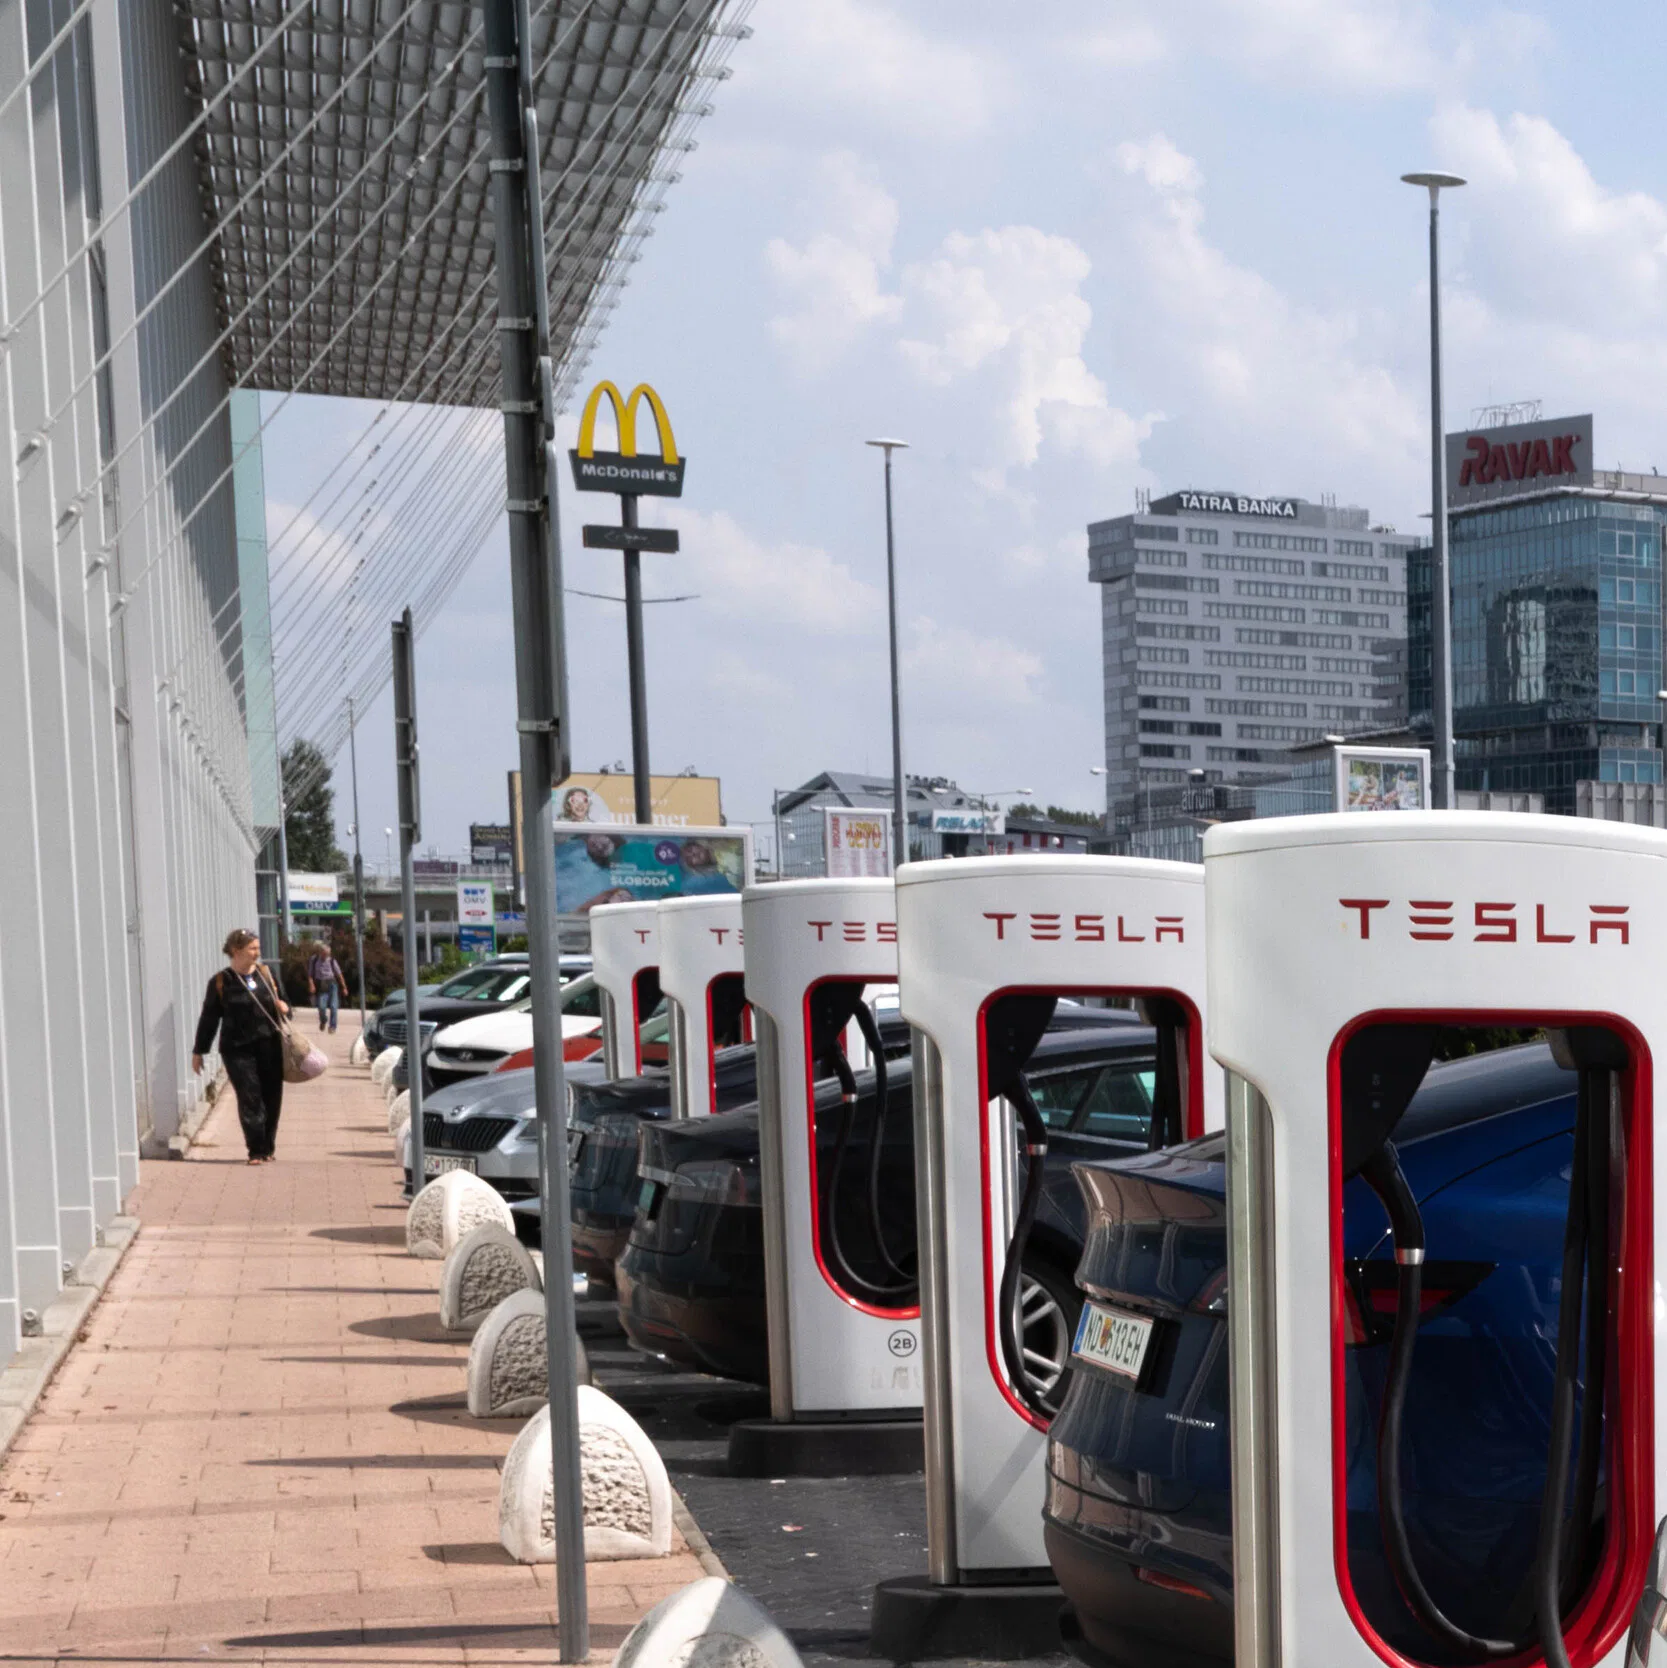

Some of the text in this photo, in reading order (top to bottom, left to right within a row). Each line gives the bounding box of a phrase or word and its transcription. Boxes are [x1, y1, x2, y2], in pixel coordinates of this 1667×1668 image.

[582, 464, 677, 482] McDonald's
[1459, 433, 1577, 486] RAVAK
[1180, 494, 1295, 517] TATRA BANKA
[983, 912, 1184, 943] TESLA
[1339, 898, 1631, 945] TESLA
[893, 1338, 912, 1349] 2B
